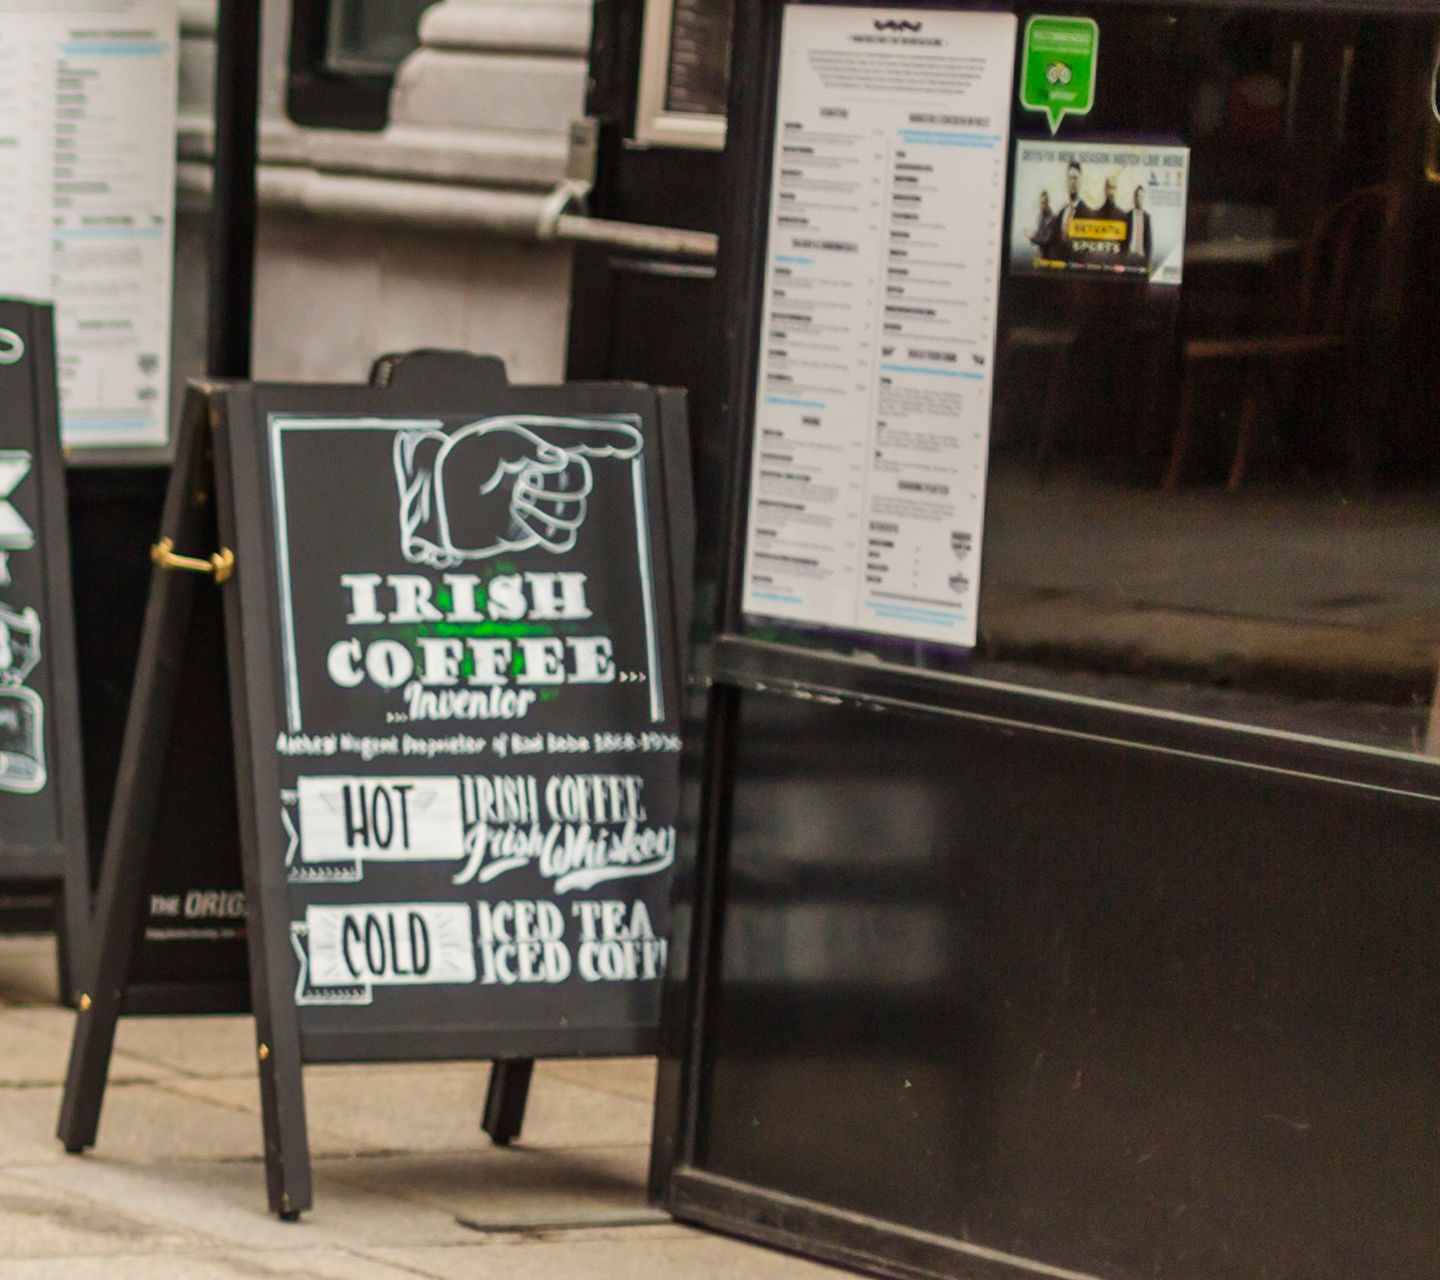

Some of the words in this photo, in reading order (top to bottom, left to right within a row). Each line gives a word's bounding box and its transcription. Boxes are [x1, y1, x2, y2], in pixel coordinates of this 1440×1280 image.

[340, 571, 593, 625] IRISH
[326, 636, 616, 688] COFFEE
[404, 681, 537, 722] Inventor
[341, 784, 414, 850] HOT
[463, 774, 539, 824] IRISH
[545, 775, 647, 823] COFFEE
[452, 821, 543, 885] Irish
[539, 822, 676, 895] Whiskey
[341, 911, 431, 978] COLD
[478, 900, 565, 942] ICED
[571, 900, 654, 942] TEA
[480, 939, 571, 985] ICED
